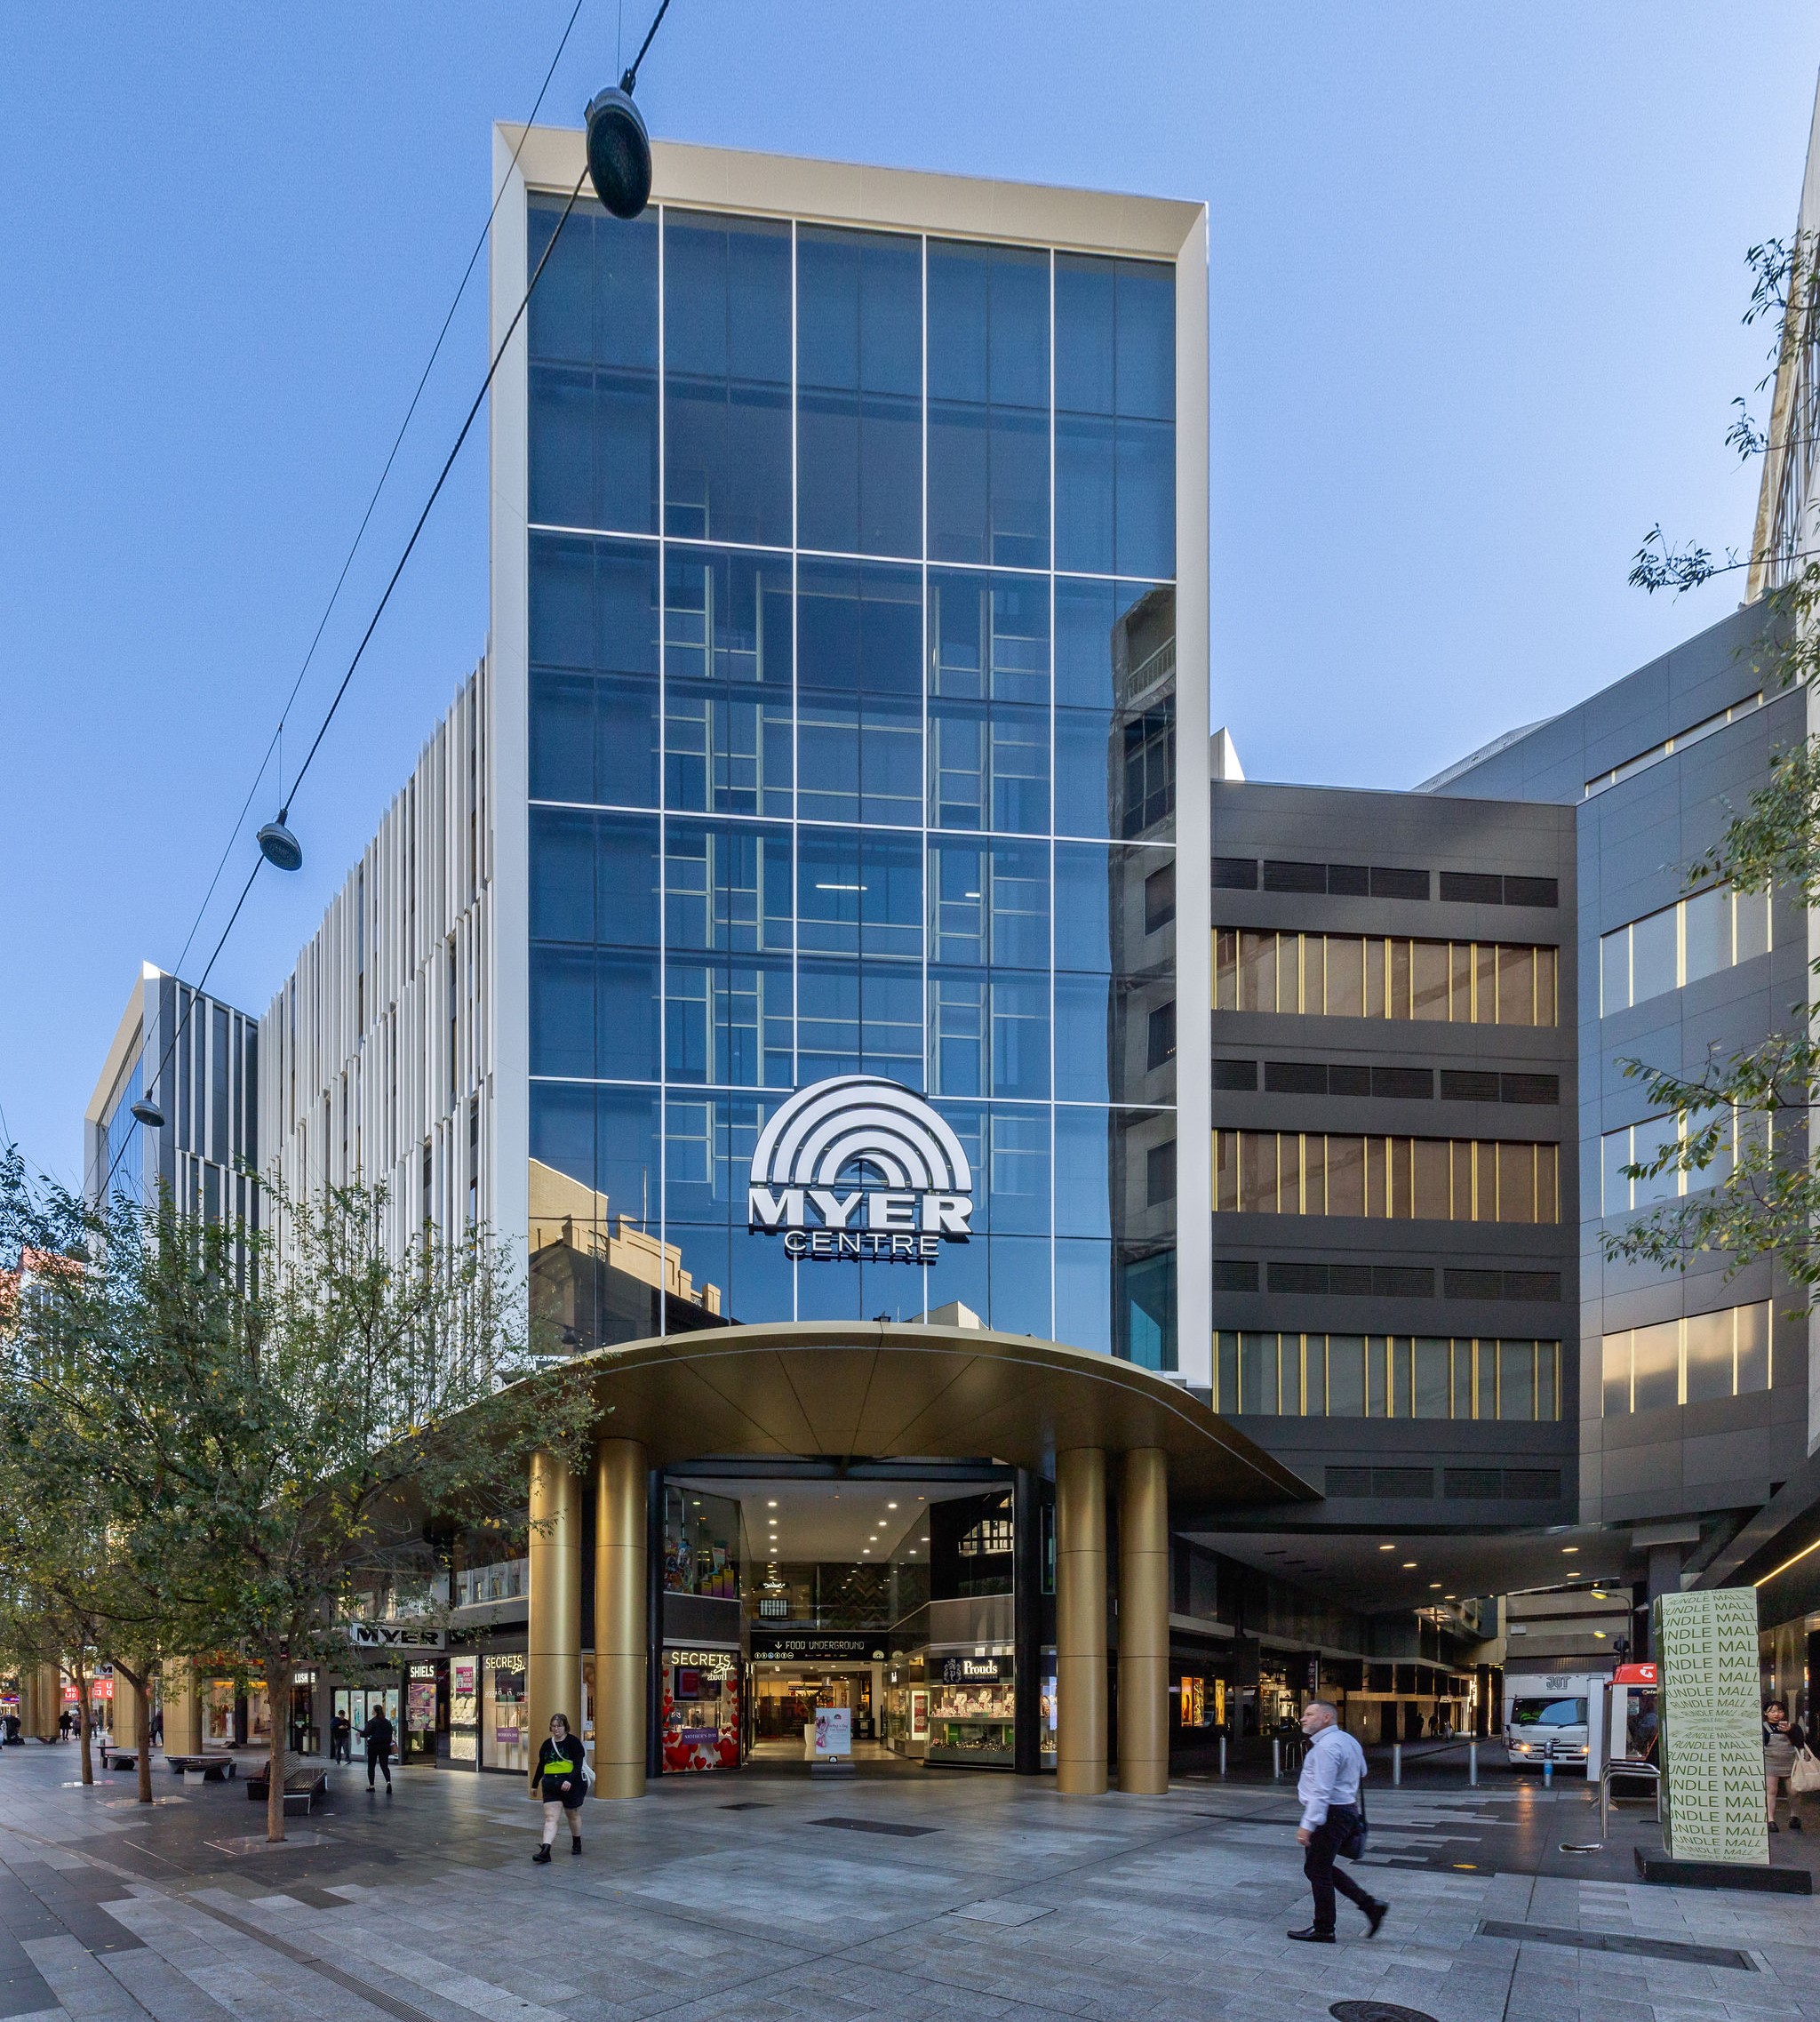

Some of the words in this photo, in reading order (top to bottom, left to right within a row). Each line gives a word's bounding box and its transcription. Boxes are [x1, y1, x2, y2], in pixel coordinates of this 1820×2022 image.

[748, 1187, 974, 1234] MYER
[784, 1230, 940, 1258] CENTRE
[1715, 1602, 1753, 1610] MALL
[1663, 1614, 1712, 1627] UNDLE
[1716, 1612, 1758, 1623] MALL
[357, 1628, 438, 1645] MYER
[786, 1641, 806, 1650] FOOD
[809, 1641, 865, 1650] UNDERGROUND
[1664, 1642, 1712, 1656] NDLE
[1719, 1641, 1756, 1652] MAL
[485, 1655, 523, 1669] SECRETS
[671, 1651, 730, 1666] SECRETS
[410, 1665, 435, 1678] SHIELS
[963, 1659, 998, 1674] Prouds
[294, 1673, 308, 1683] LUSH
[1665, 1672, 1713, 1685] UNDLE
[1719, 1672, 1760, 1682] MALL
[1718, 1686, 1753, 1696] MALL
[1671, 1698, 1713, 1709] RUNDLE
[1717, 1698, 1747, 1707] MALL
[1672, 1740, 1715, 1750] RUNDLE
[1719, 1740, 1752, 1749] MALL
[1721, 1753, 1760, 1762] MALL
[1669, 1764, 1717, 1776] UNDLE
[1722, 1765, 1766, 1776] MALL
[1671, 1794, 1720, 1808] NDLE
[1726, 1796, 1764, 1808] MAL
[1672, 1823, 1720, 1835] UNDLE
[1726, 1826, 1767, 1836] MALL
